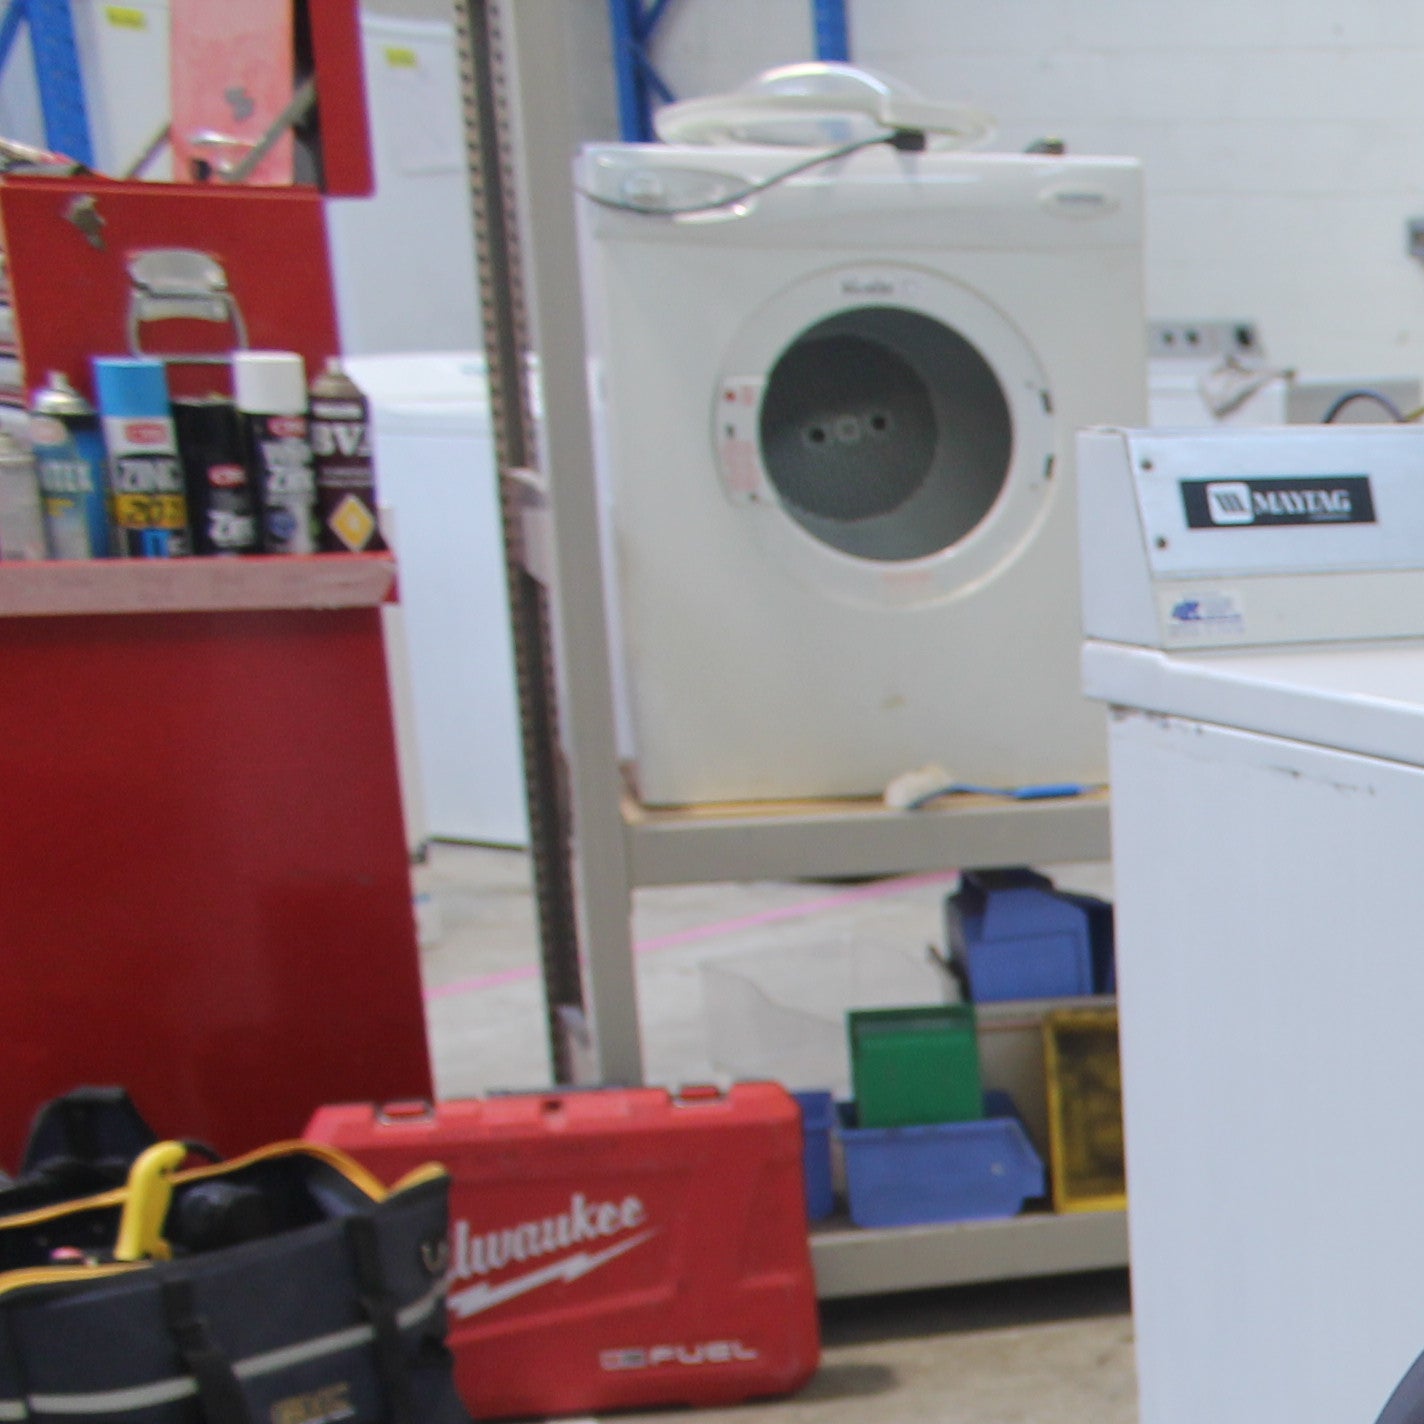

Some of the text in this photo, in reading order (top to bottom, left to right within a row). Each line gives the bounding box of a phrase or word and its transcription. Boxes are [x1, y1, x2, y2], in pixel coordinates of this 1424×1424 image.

[1252, 489, 1352, 516] MAYTAG
[447, 1192, 648, 1280] lwaukee
[650, 1339, 759, 1367] FUEL
